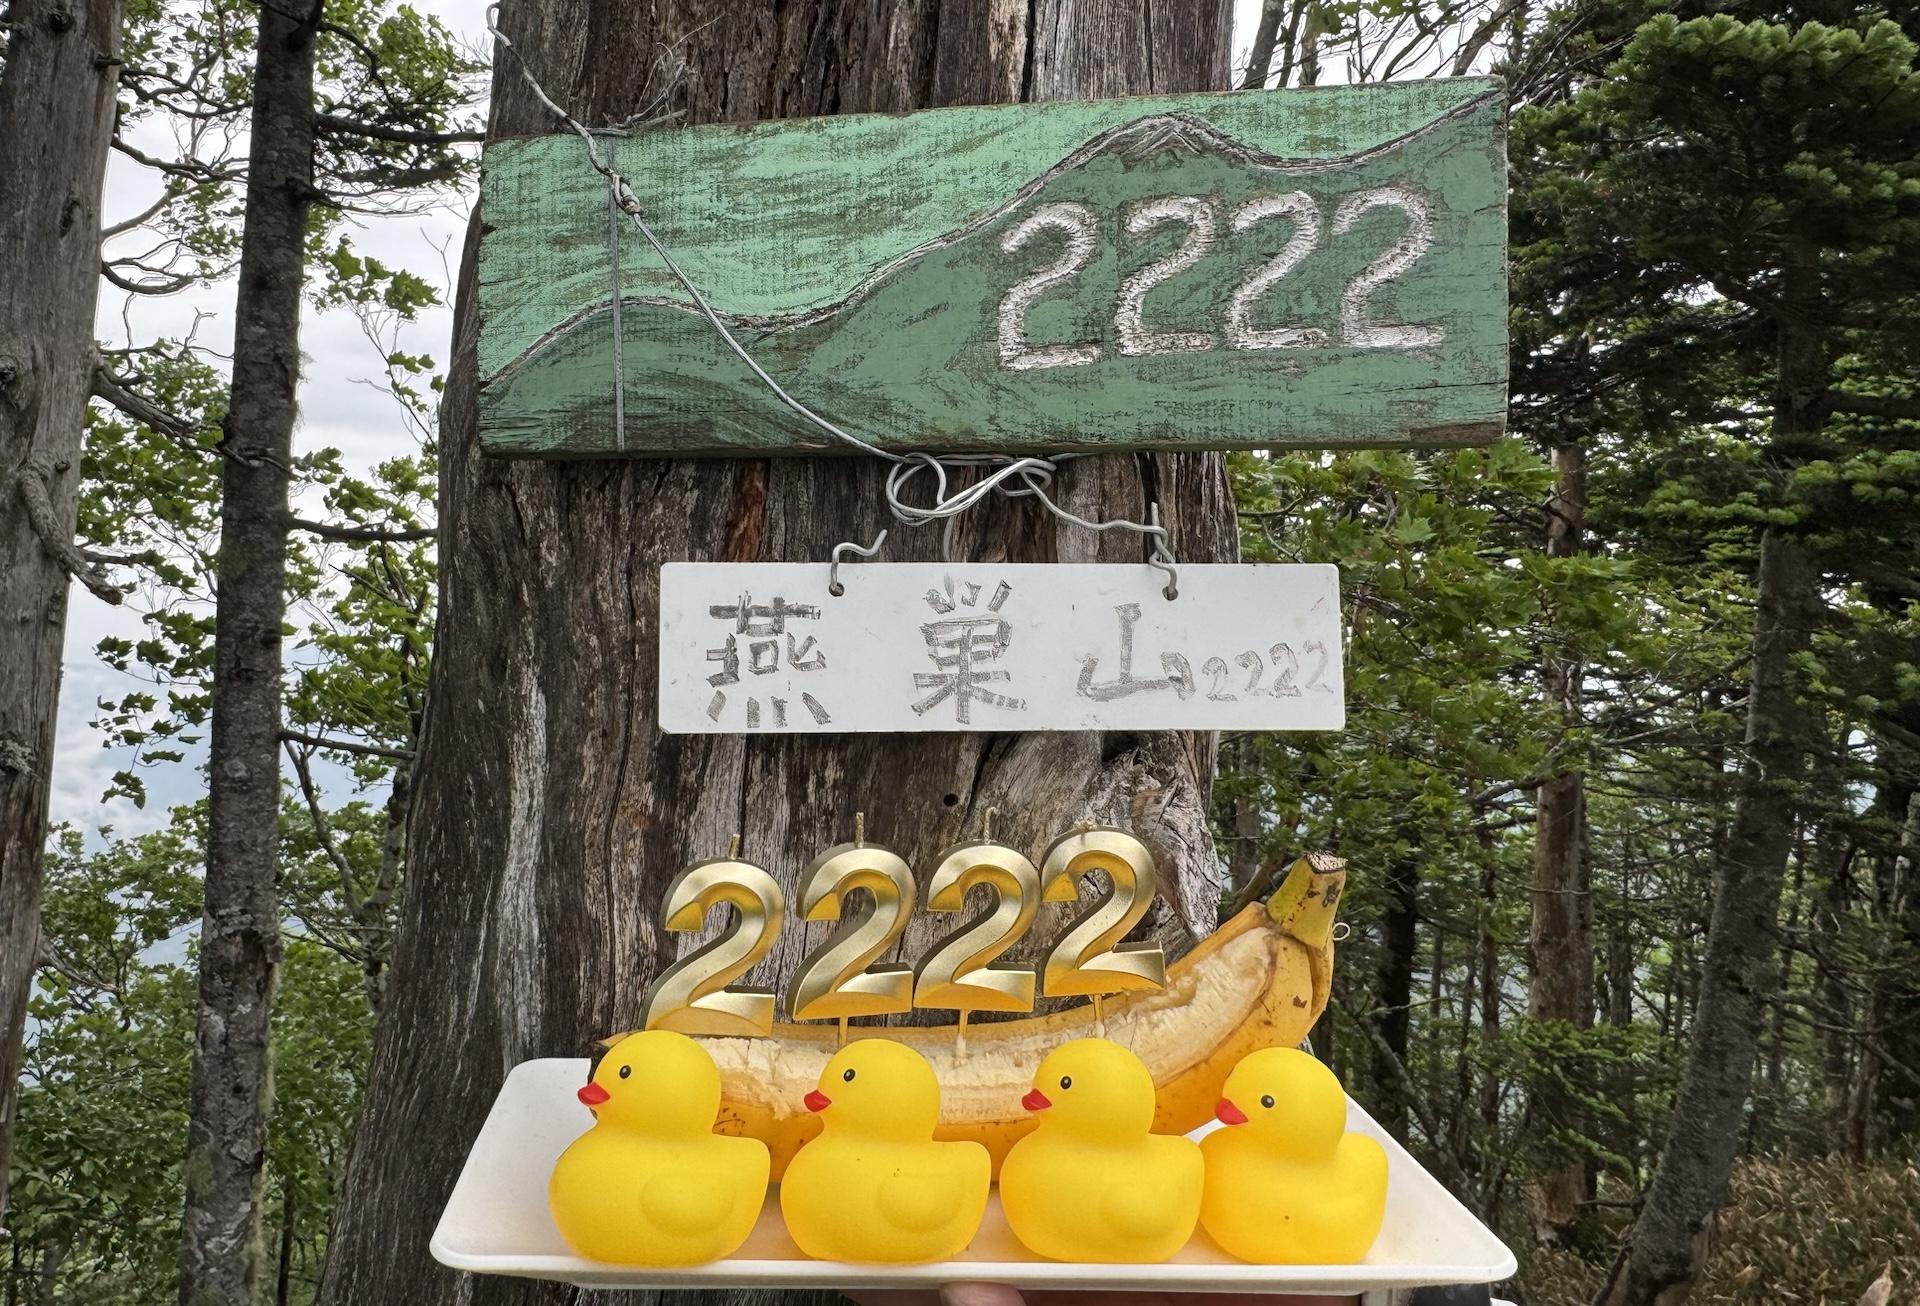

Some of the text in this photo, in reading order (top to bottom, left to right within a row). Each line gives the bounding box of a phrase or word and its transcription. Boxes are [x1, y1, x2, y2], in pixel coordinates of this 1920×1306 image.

[1000, 186, 1444, 371] 2222
[1202, 640, 1334, 701] 2222
[641, 825, 1166, 1037] 2222
